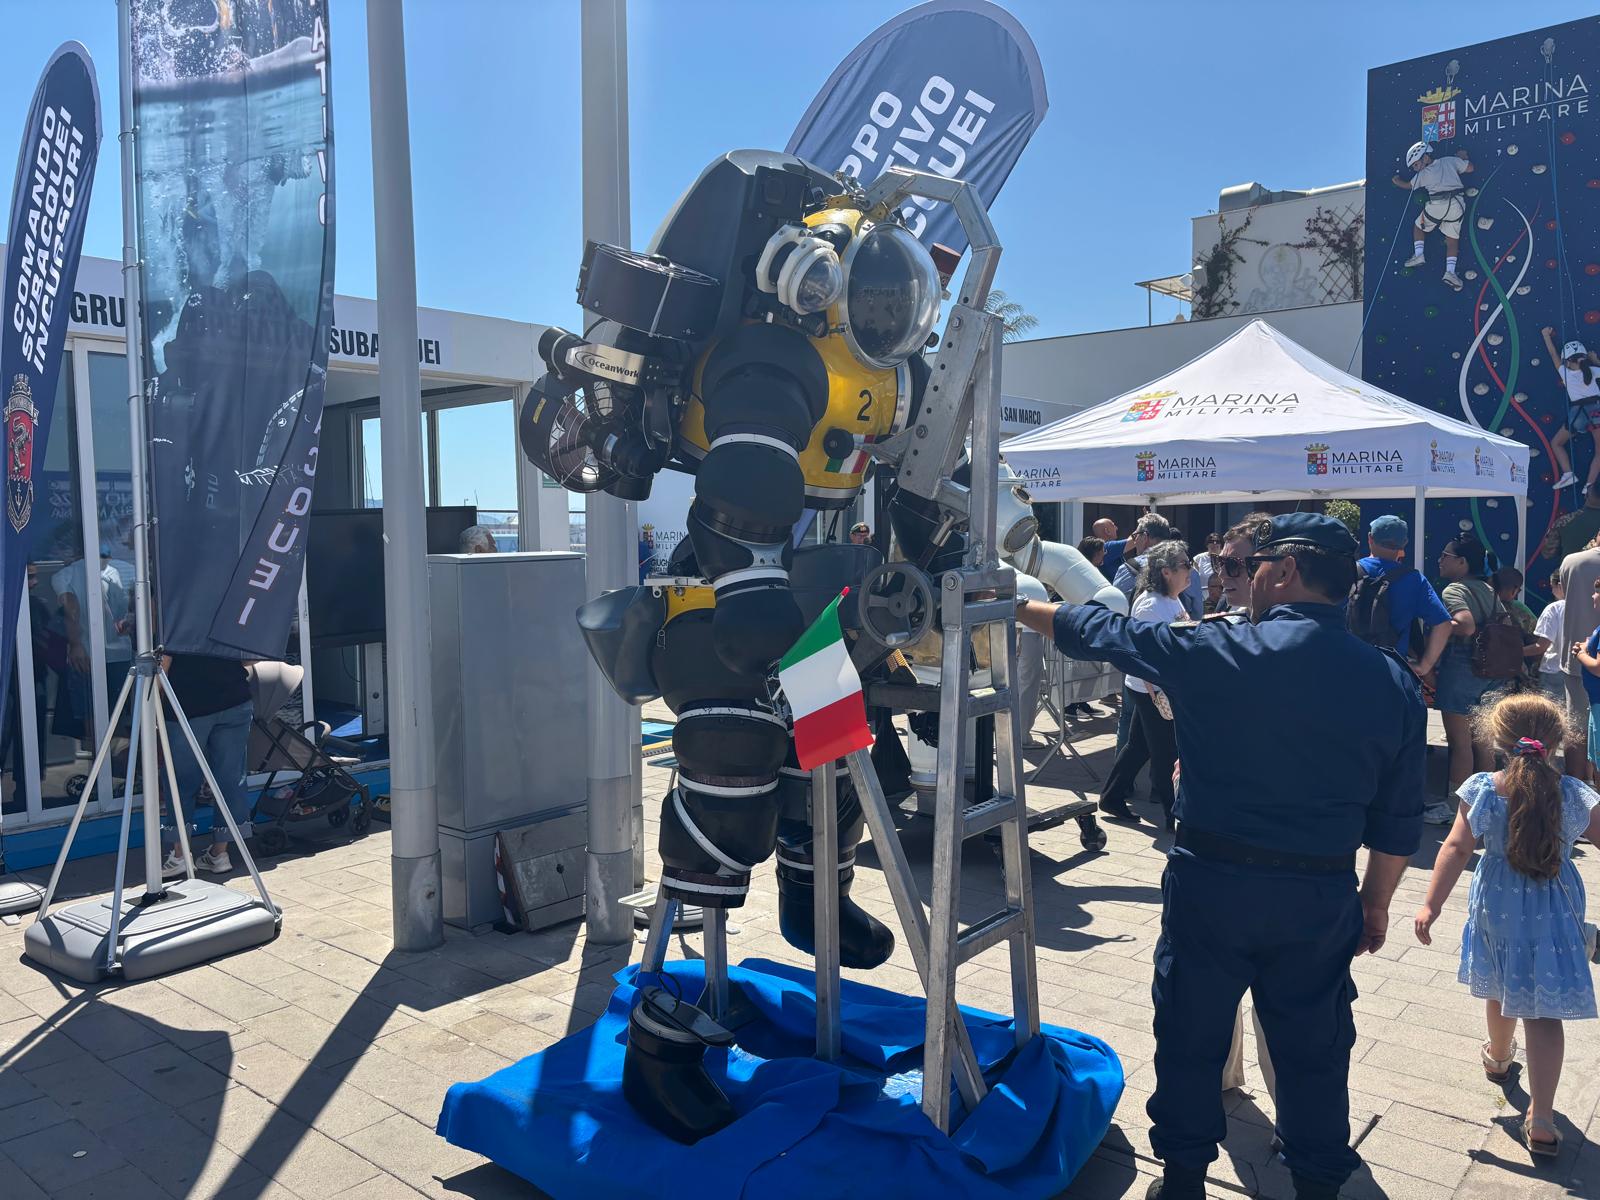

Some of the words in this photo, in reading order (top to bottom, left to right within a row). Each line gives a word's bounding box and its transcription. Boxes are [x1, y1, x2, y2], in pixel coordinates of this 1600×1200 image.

[1465, 74, 1588, 117] MARINA
[1464, 100, 1589, 135] MILITARE
[838, 91, 903, 186] PPO
[13, 106, 56, 333] COMANDO
[22, 106, 72, 362] SUBACQUEI
[33, 126, 84, 375] INCURSORI
[70, 291, 141, 328] GRU
[588, 358, 640, 378] OceanWork
[856, 389, 873, 422] 2
[1171, 393, 1300, 409] MARINA
[1004, 406, 1018, 423] SAN
[1019, 408, 1041, 426] MARCO
[1164, 406, 1298, 418] MILITARE
[1157, 456, 1217, 470] MARINA
[1332, 449, 1403, 463] MARINA
[1013, 466, 1062, 479] MARINA
[1157, 470, 1217, 480] MILITARE
[1332, 464, 1404, 474] MILITARE
[655, 531, 686, 541] MARIN
